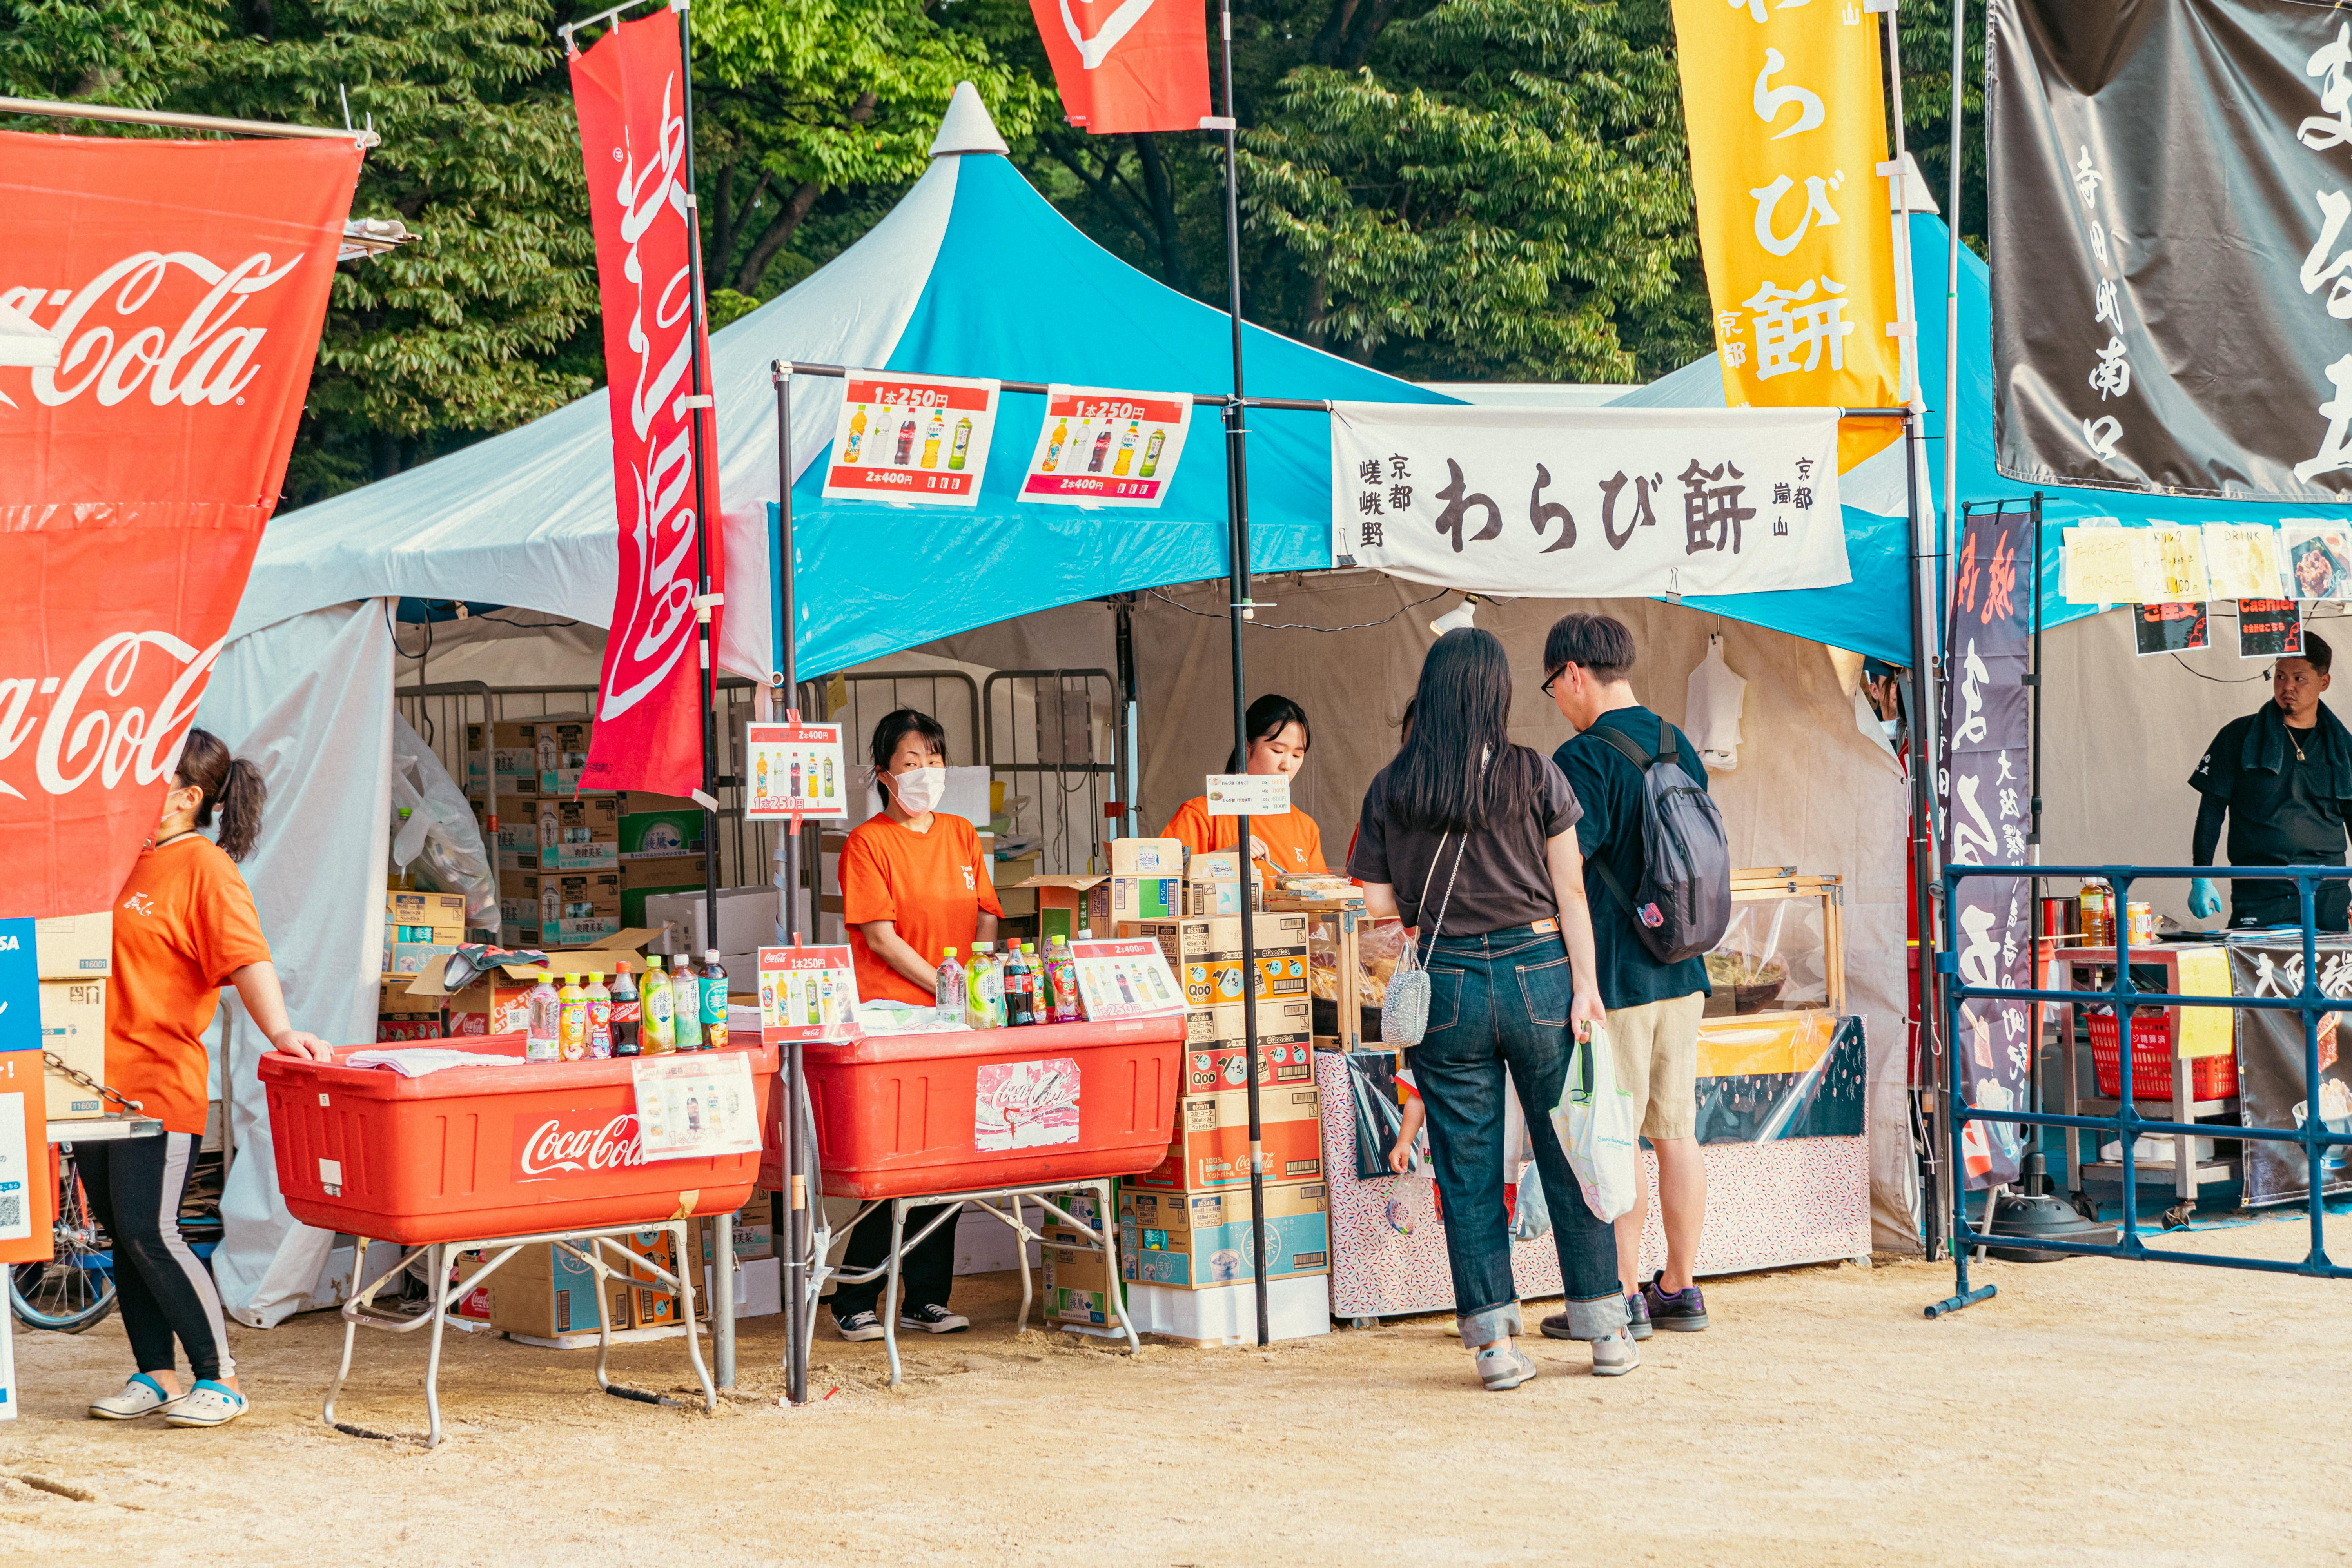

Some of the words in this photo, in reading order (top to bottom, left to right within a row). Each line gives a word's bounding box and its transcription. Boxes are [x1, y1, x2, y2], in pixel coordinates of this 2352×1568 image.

[1717, 310, 1746, 369] 京都
[601, 71, 710, 722] Coca-Cola
[875, 387, 948, 408] 1本250円
[1076, 401, 1145, 421] 1本250円
[866, 471, 913, 485] 2本400円
[1060, 479, 1103, 490] 2本400円
[1388, 453, 1412, 512] 京都
[1793, 457, 1814, 511] 京都
[1359, 459, 1384, 548] 嵯峨野
[1434, 457, 1757, 555] わらび餅
[1772, 483, 1791, 537] 嵐山
[2224, 530, 2261, 541] DRINK
[2239, 599, 2296, 614] Cashier
[0, 630, 227, 795] a-Col
[799, 730, 828, 740] 2本400円
[753, 795, 804, 810] 1本250円
[644, 837, 668, 850] 綾鷹
[575, 848, 603, 857] 爽健美茶
[576, 922, 604, 933] 爽健美茶
[1115, 945, 1146, 954] 2本400円
[1262, 948, 1290, 957] #Qooダンス
[765, 952, 787, 963] Coca-Cola
[791, 958, 826, 969] 1本250円
[80, 960, 106, 969] 116001
[986, 974, 996, 997] 綾鷹
[1189, 984, 1211, 996] Qoo
[495, 999, 518, 1018] Coke
[657, 991, 668, 1015] 綾鷹
[1093, 1003, 1142, 1018] 1本250円
[802, 1028, 820, 1036] Coca-Cola
[1267, 1035, 1294, 1044] #Qooダンス
[1192, 1072, 1216, 1084] Qoo
[73, 1102, 98, 1110] 116001
[322, 1095, 327, 1104] 5
[1205, 1163, 1231, 1172] リサイクル
[1235, 1152, 1275, 1172] Cocola
[1069, 1205, 1087, 1218] 綾鷹
[1122, 1230, 1136, 1242] 麦茶
[1158, 1261, 1171, 1272] 麦茶
[1069, 1297, 1085, 1310] 綾鷹
